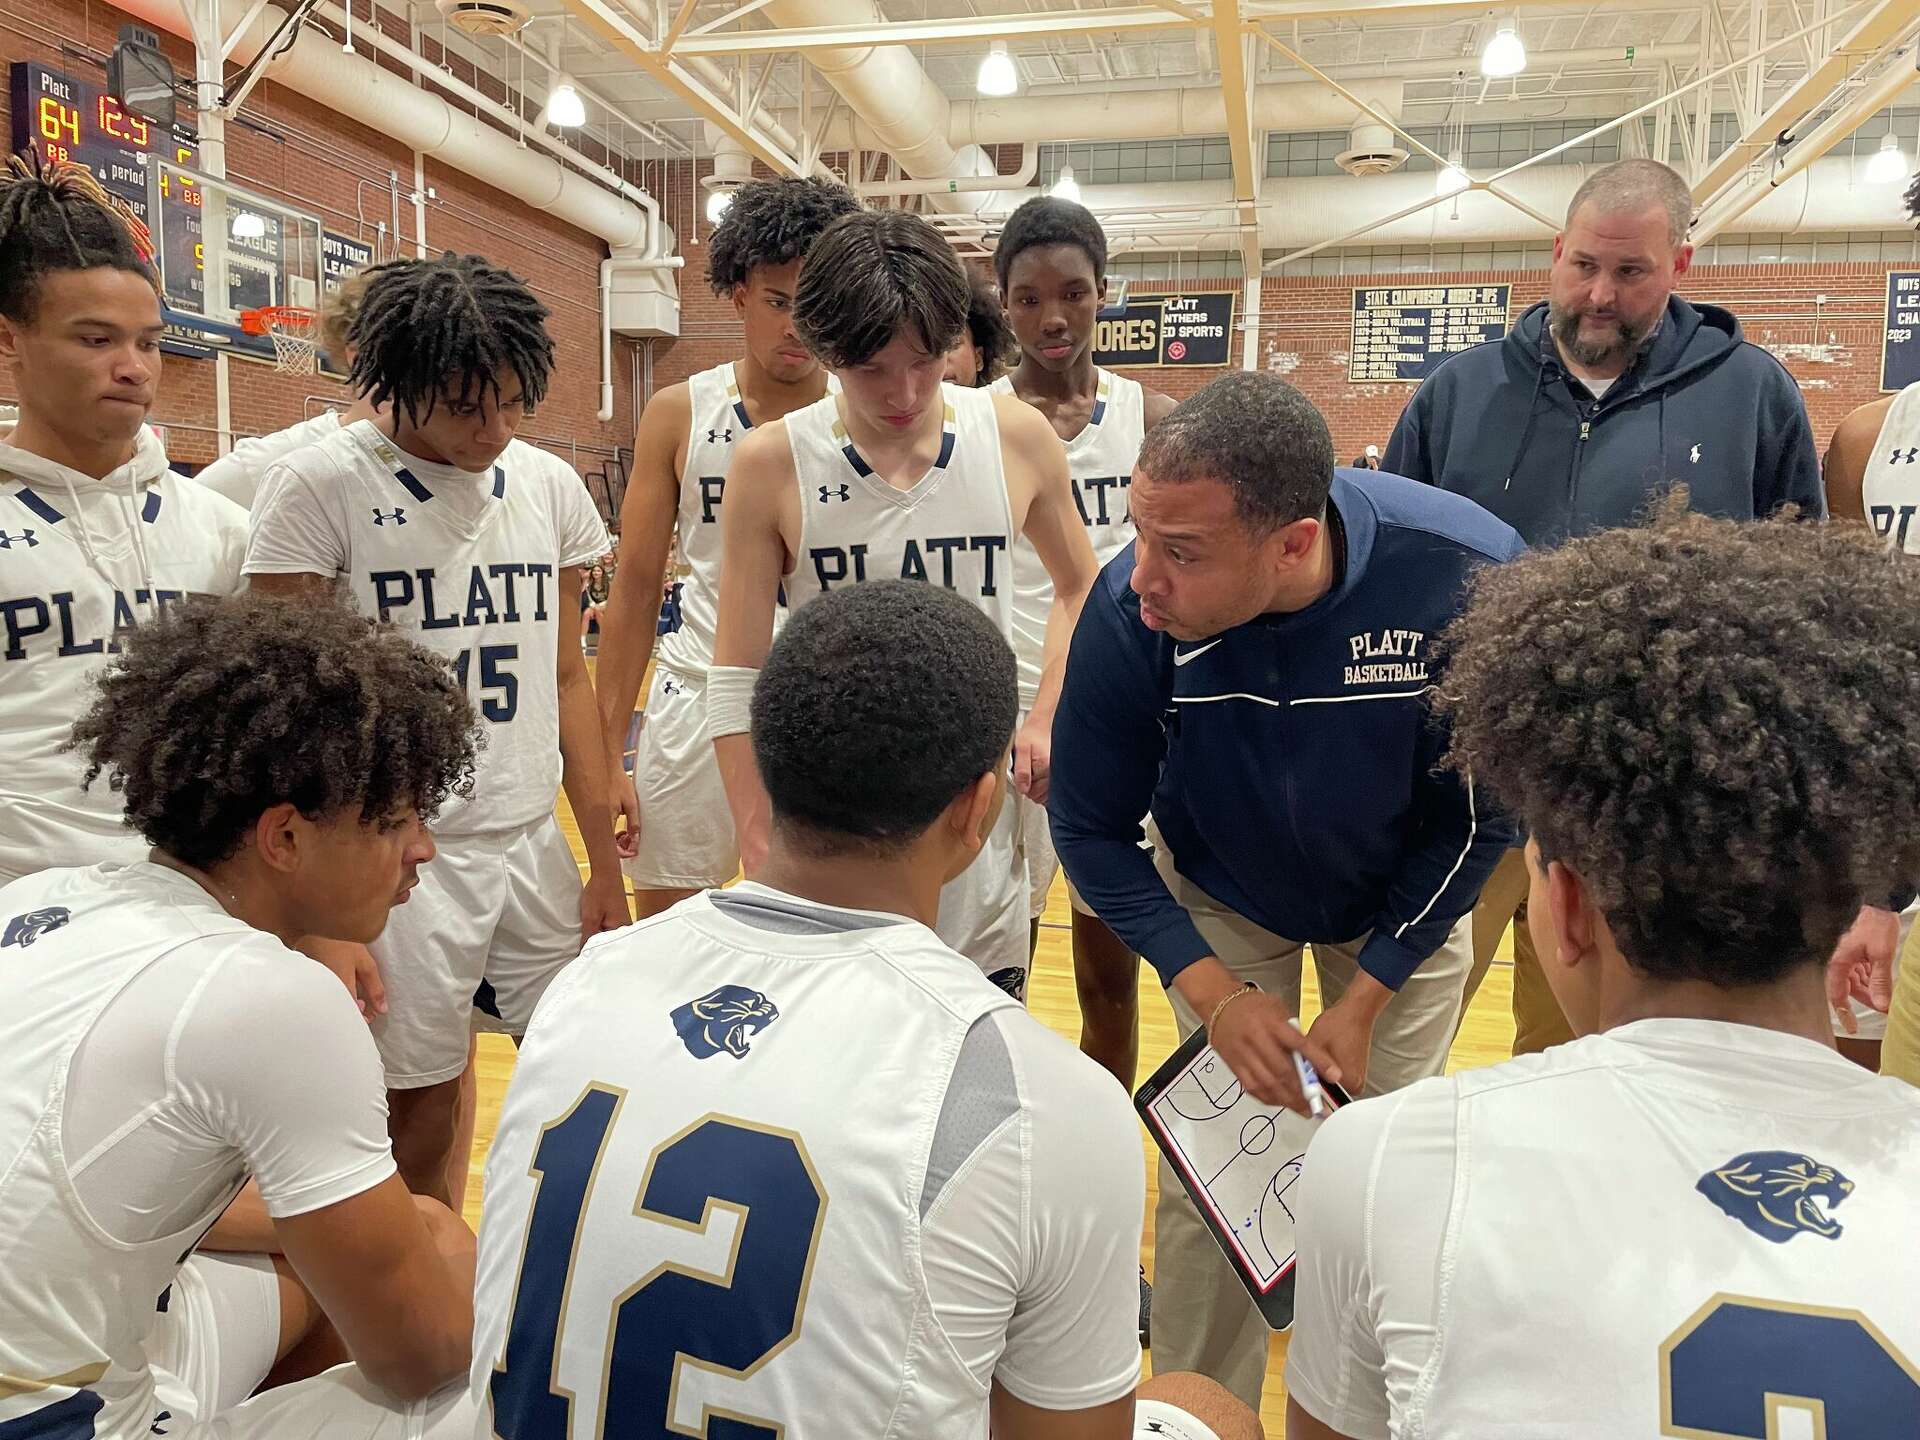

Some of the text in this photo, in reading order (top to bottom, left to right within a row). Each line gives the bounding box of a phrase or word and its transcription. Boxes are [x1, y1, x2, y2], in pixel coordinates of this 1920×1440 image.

[41, 72, 70, 100] Platt
[40, 97, 79, 145] 64
[112, 165, 145, 186] period
[323, 237, 369, 265] BOYS TRACK
[1365, 291, 1389, 305] STATE
[1164, 313, 1208, 323] NTHERS
[1179, 326, 1223, 338] SPORTS
[370, 563, 552, 630] PLATT
[0, 589, 183, 660] PLAT
[1349, 629, 1424, 660] PLATT
[1344, 662, 1429, 685] BASKETBALL
[487, 1079, 830, 1440] 12
